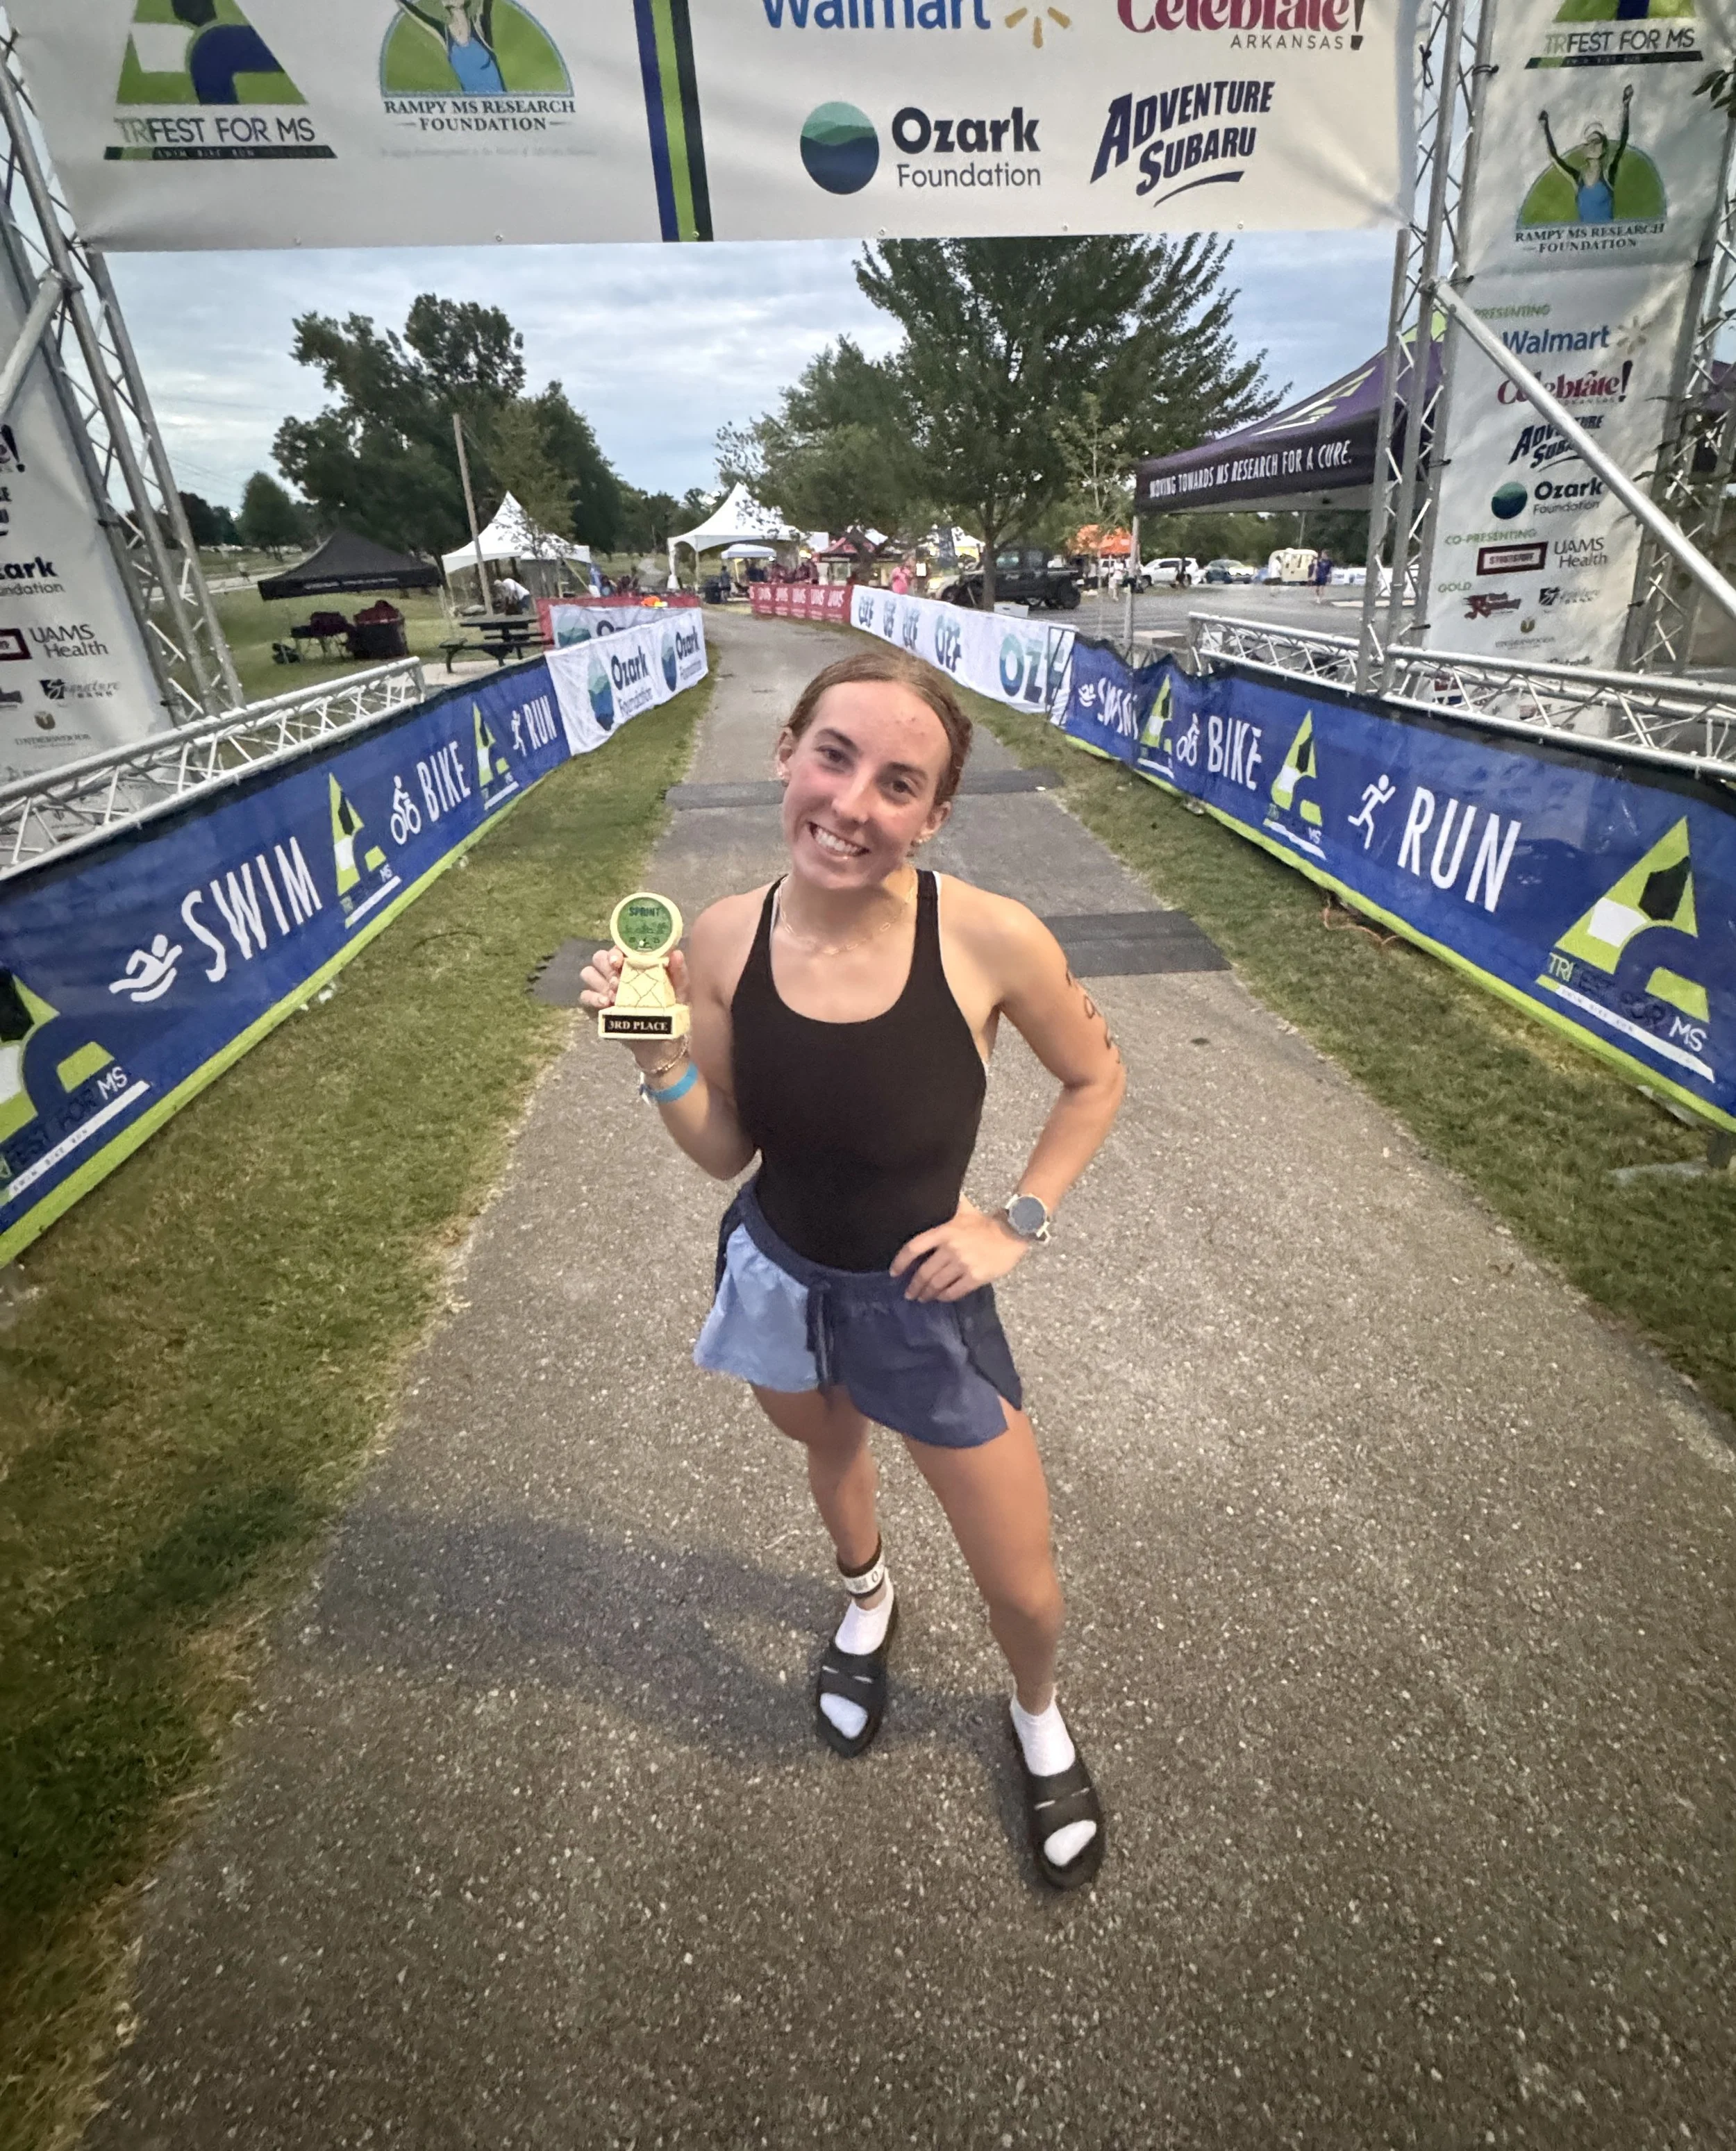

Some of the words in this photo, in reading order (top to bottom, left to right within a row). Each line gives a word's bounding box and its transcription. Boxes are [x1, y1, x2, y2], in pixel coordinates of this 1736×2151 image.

[1230, 33, 1344, 50] ARKANSAS
[1619, 28, 1660, 51] FOR
[1666, 27, 1695, 49] MS
[384, 100, 447, 114] RAMPY
[451, 100, 479, 114] MS
[483, 99, 576, 114] RESEARCH
[215, 117, 273, 142] FOR
[276, 117, 316, 142] MS
[419, 117, 547, 132] FOUNDATION
[892, 106, 1041, 155] Ozark
[1089, 81, 1276, 185] ADVENTURE
[1136, 126, 1257, 196] SUBARU
[896, 162, 1041, 188] Foundation
[1515, 230, 1564, 242] RAMPY
[1568, 227, 1587, 238] MS
[1591, 223, 1665, 237] RESEARCH
[1539, 238, 1637, 253] FOUNDATION
[1502, 324, 1611, 355] Walmart
[1178, 467, 1215, 492] TOWARDS
[1215, 462, 1230, 485] MS
[1230, 453, 1278, 483] RESEARCH
[1282, 448, 1303, 475] FOR
[1305, 446, 1314, 470] A
[1317, 440, 1353, 469] CURE.
[1534, 477, 1604, 501] Ozark
[1533, 499, 1601, 515] Foundation
[1444, 528, 1537, 546] CO-PRESENTING
[1553, 537, 1605, 555] UAMS
[0, 556, 58, 580] ark
[1558, 551, 1609, 569] Health
[1437, 581, 1472, 594] GOLD
[28, 623, 95, 644] UAMS
[675, 625, 701, 660] Ozark
[44, 639, 109, 659] Health
[610, 645, 650, 691] Ozark
[522, 694, 558, 750] RUN
[1208, 715, 1262, 791] BIKE
[416, 741, 471, 822] BIKE
[1396, 786, 1522, 914] RUN
[181, 836, 323, 982] SWIM
[1549, 952, 1574, 982] TRI
[1669, 1016, 1708, 1053] MS
[608, 1020, 631, 1030] 3RD
[633, 1020, 668, 1032] PLACE
[97, 1066, 128, 1100] MS
